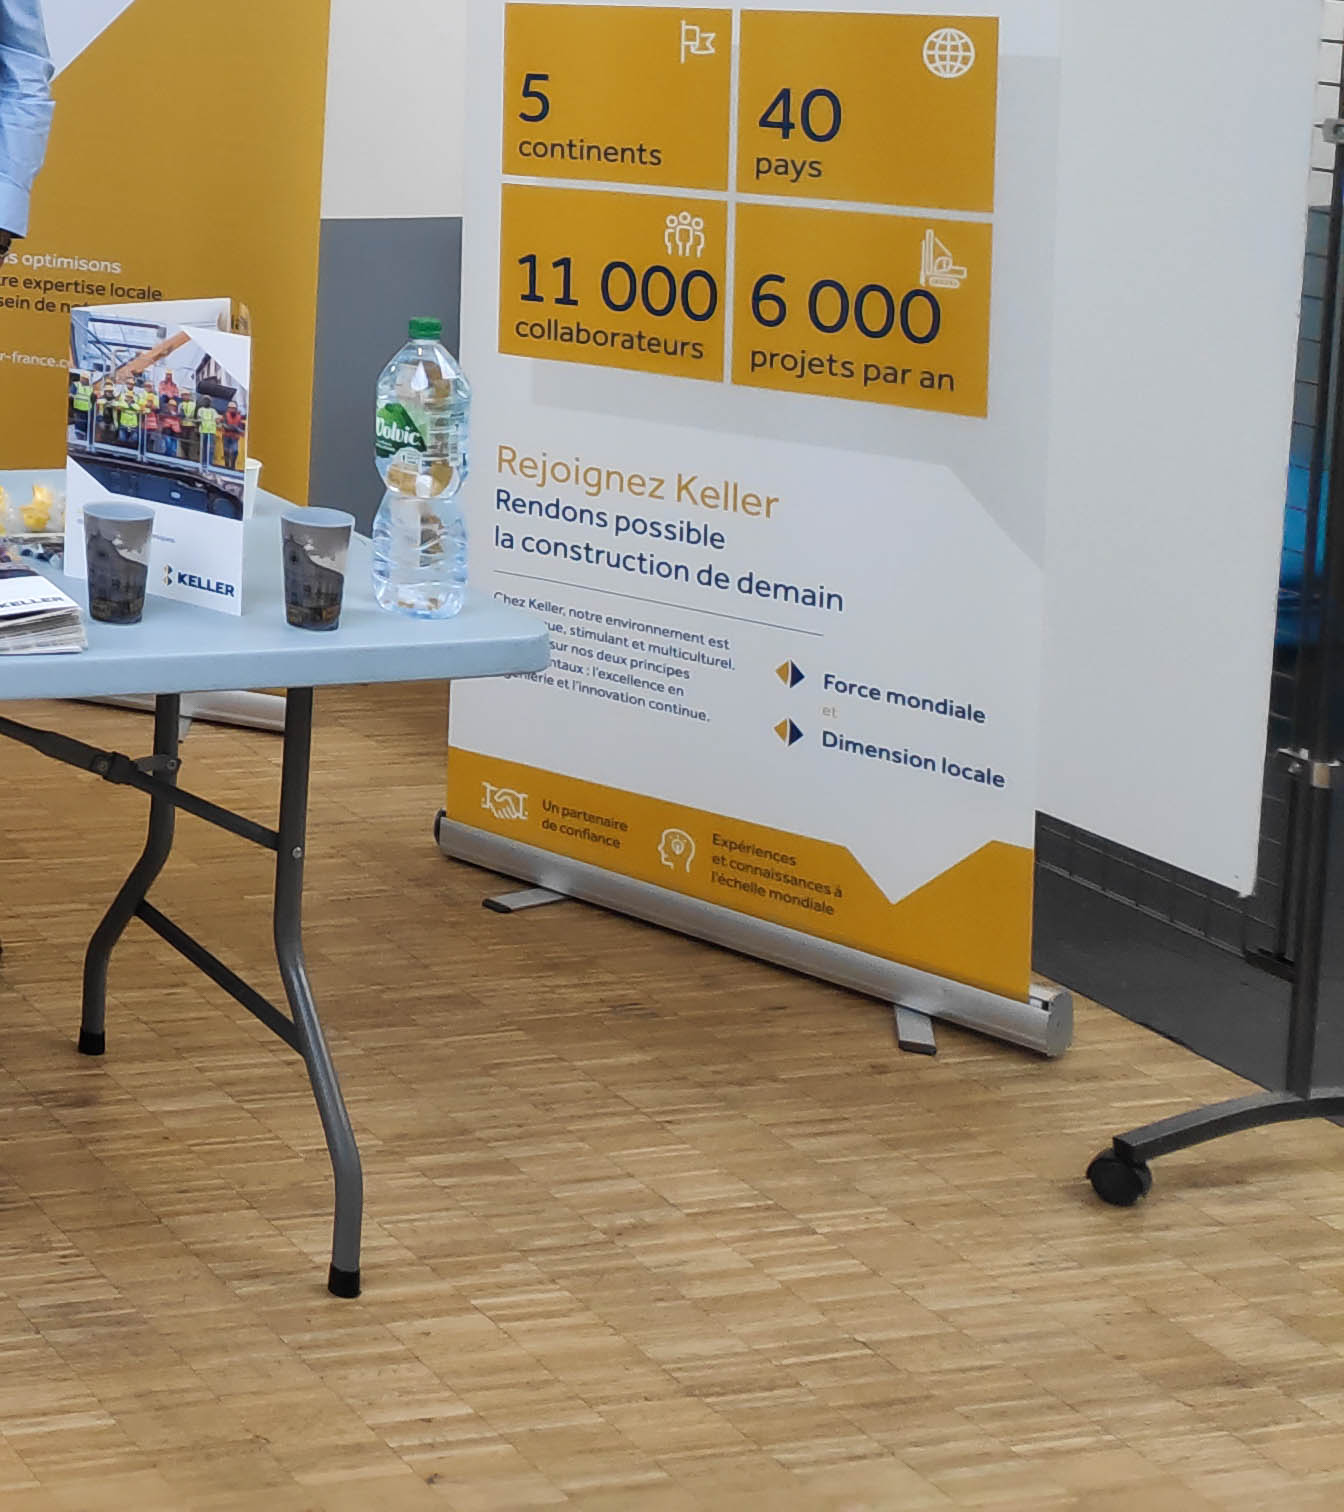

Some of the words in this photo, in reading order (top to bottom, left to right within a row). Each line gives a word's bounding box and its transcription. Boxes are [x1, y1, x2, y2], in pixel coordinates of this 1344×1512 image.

[518, 73, 550, 123] 5
[757, 87, 843, 143] 40
[518, 137, 663, 168] continents
[754, 153, 823, 181] pays
[22, 253, 122, 274] optimisons
[23, 276, 106, 295] expertise
[110, 283, 162, 301] locale
[36, 297, 56, 312] de
[518, 253, 580, 307] 11
[600, 260, 718, 322] 000
[750, 274, 788, 328] 6
[807, 278, 942, 344] 000
[514, 316, 704, 360] collaborateurs
[750, 346, 856, 381] projets
[862, 362, 912, 388] par
[918, 369, 956, 392] an
[496, 443, 665, 501] Rejoignez
[676, 472, 780, 519] Keller
[496, 487, 608, 529] Rendons
[614, 513, 725, 551] possible
[177, 572, 235, 598] KELLER
[495, 524, 514, 551] la
[521, 535, 689, 583] construction
[696, 563, 730, 591] de
[737, 570, 843, 612] demain
[822, 704, 837, 720] et
[823, 672, 881, 702] Force
[886, 690, 986, 725] mondiale
[822, 729, 936, 773] Dimension
[941, 756, 1005, 789] locale
[539, 818, 559, 833] de
[559, 823, 623, 850] confiance
[542, 798, 562, 818] Un
[561, 806, 629, 833] partenaire
